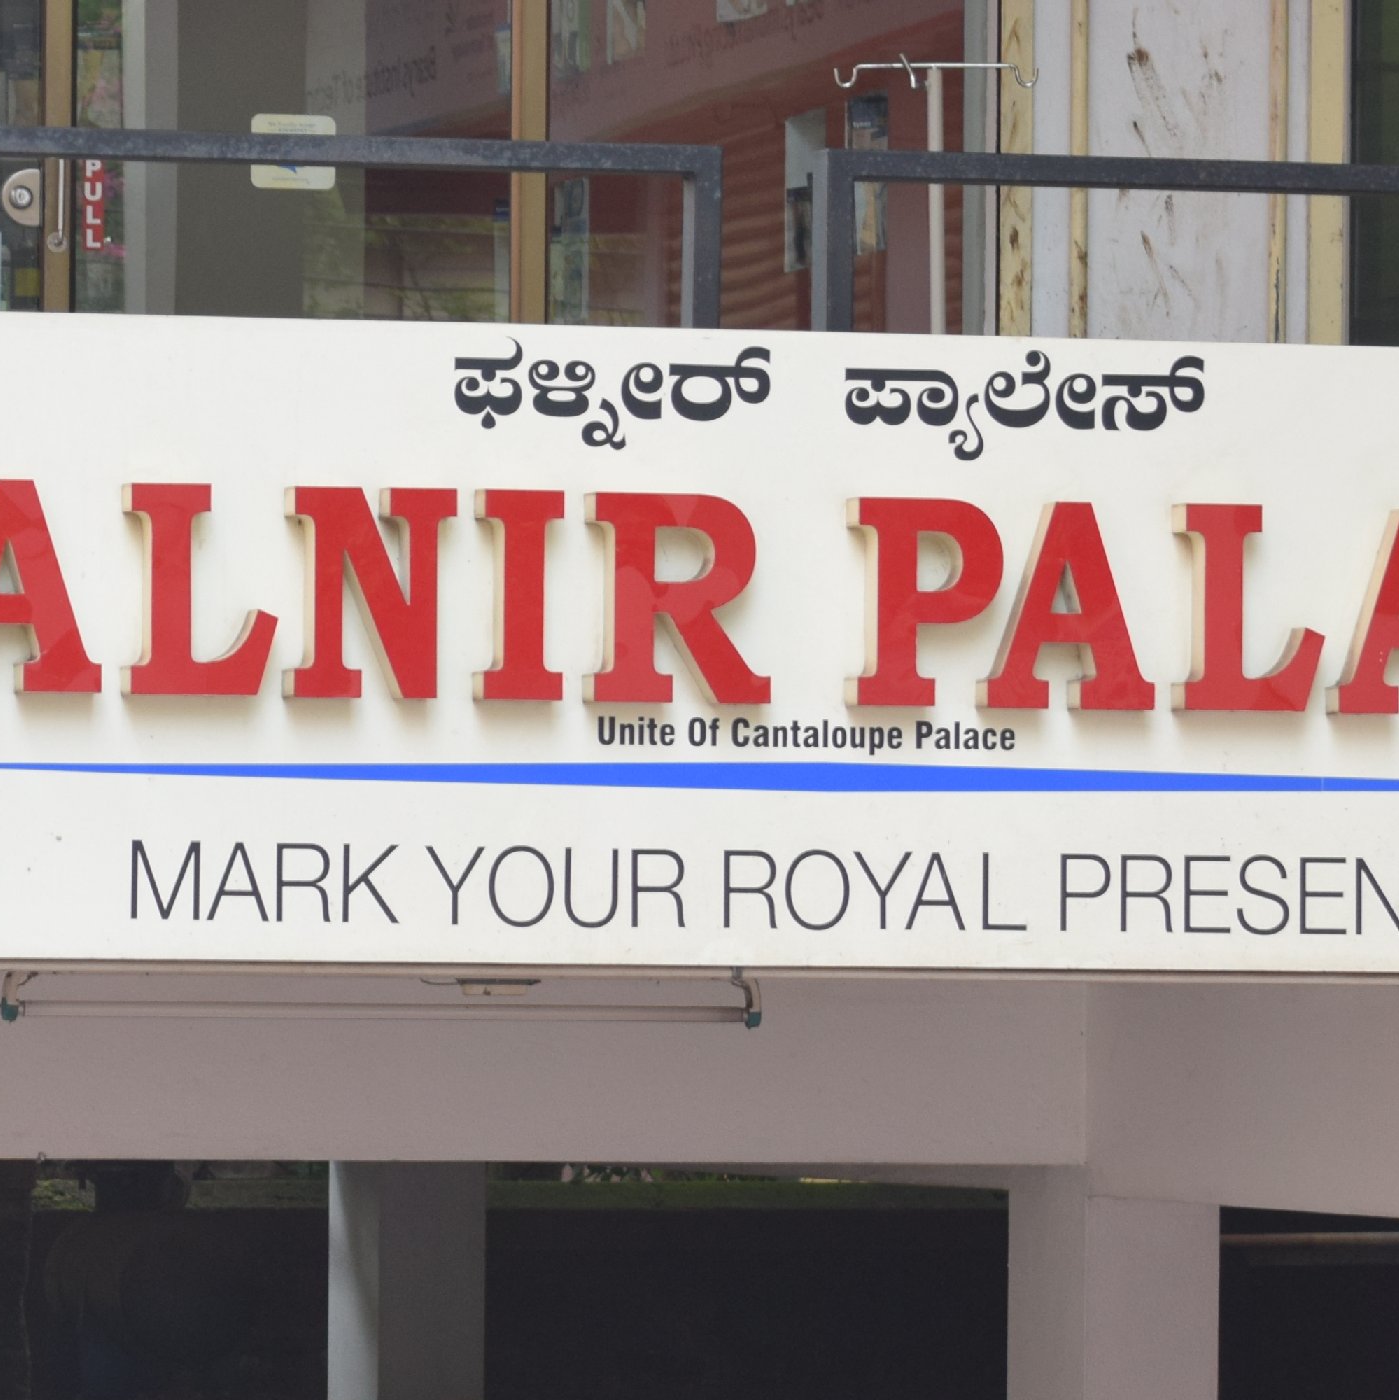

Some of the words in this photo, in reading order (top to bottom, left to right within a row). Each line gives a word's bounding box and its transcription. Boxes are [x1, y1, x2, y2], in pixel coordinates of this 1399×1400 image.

[84, 159, 103, 249] PULL
[844, 350, 1205, 461] ಪ್ಯಾಲೇಸ್
[597, 716, 675, 746] Unite
[688, 717, 720, 747] Of
[731, 717, 903, 756] Cantaloupe
[915, 720, 1016, 751] Palace
[131, 840, 398, 923] MARK
[426, 846, 685, 928] YOUR
[723, 849, 1027, 931] ROYAL
